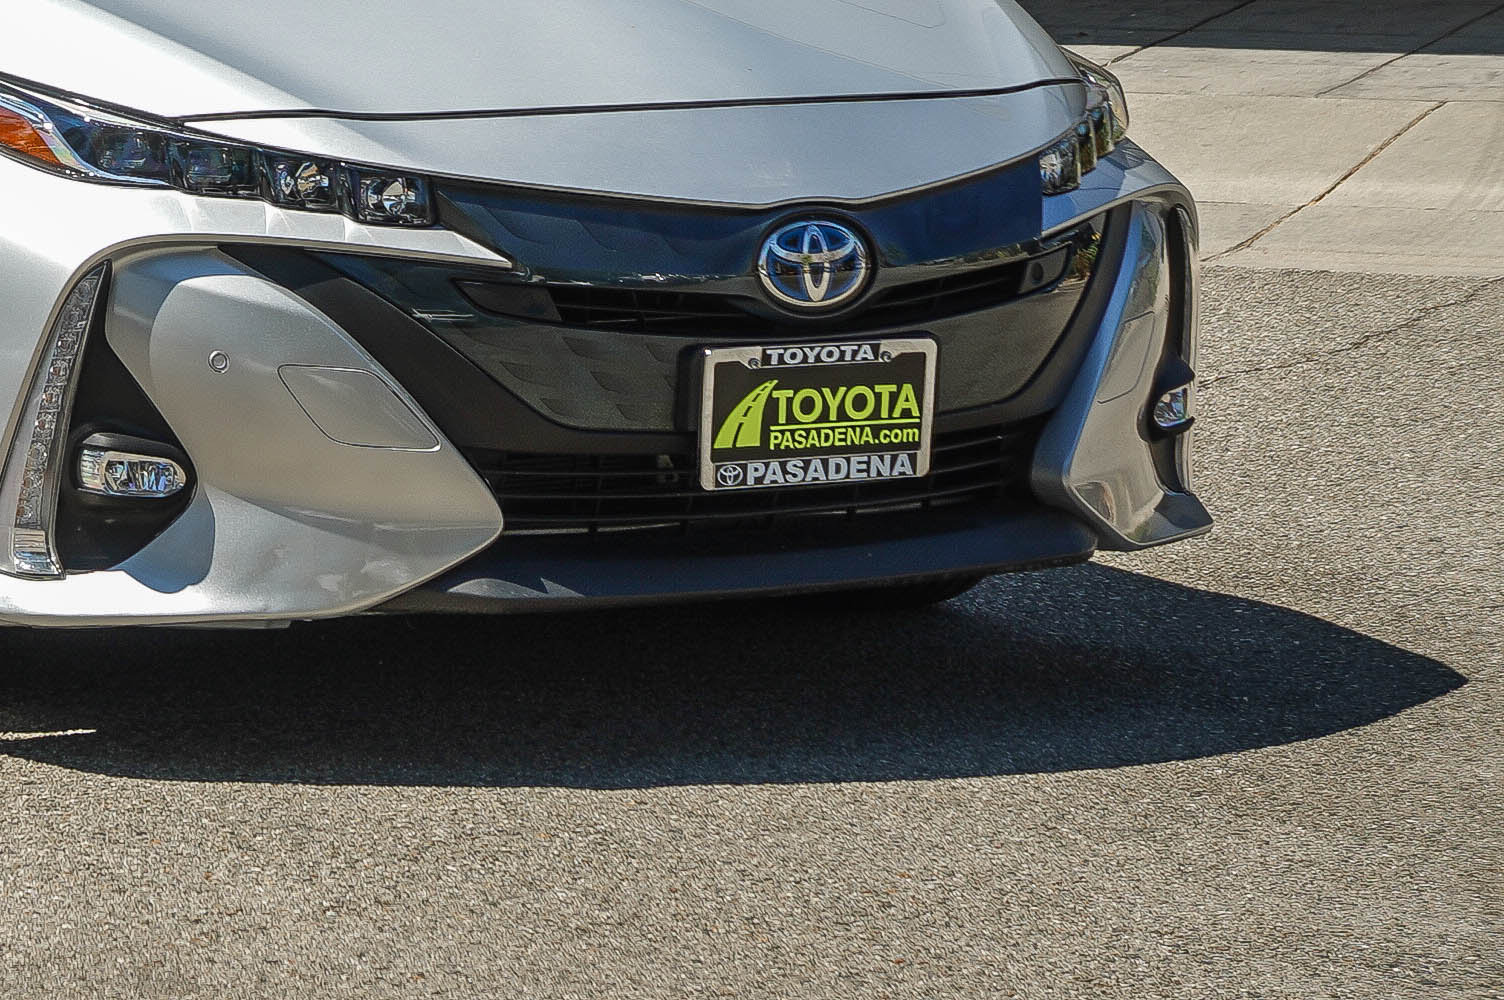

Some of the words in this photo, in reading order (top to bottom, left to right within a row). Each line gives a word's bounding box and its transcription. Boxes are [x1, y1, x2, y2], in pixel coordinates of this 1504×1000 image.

[765, 344, 875, 365] TOYOTA
[771, 383, 920, 424] TOYOTA
[769, 426, 920, 450] PASADENA.com
[746, 453, 914, 486] PASADENA
